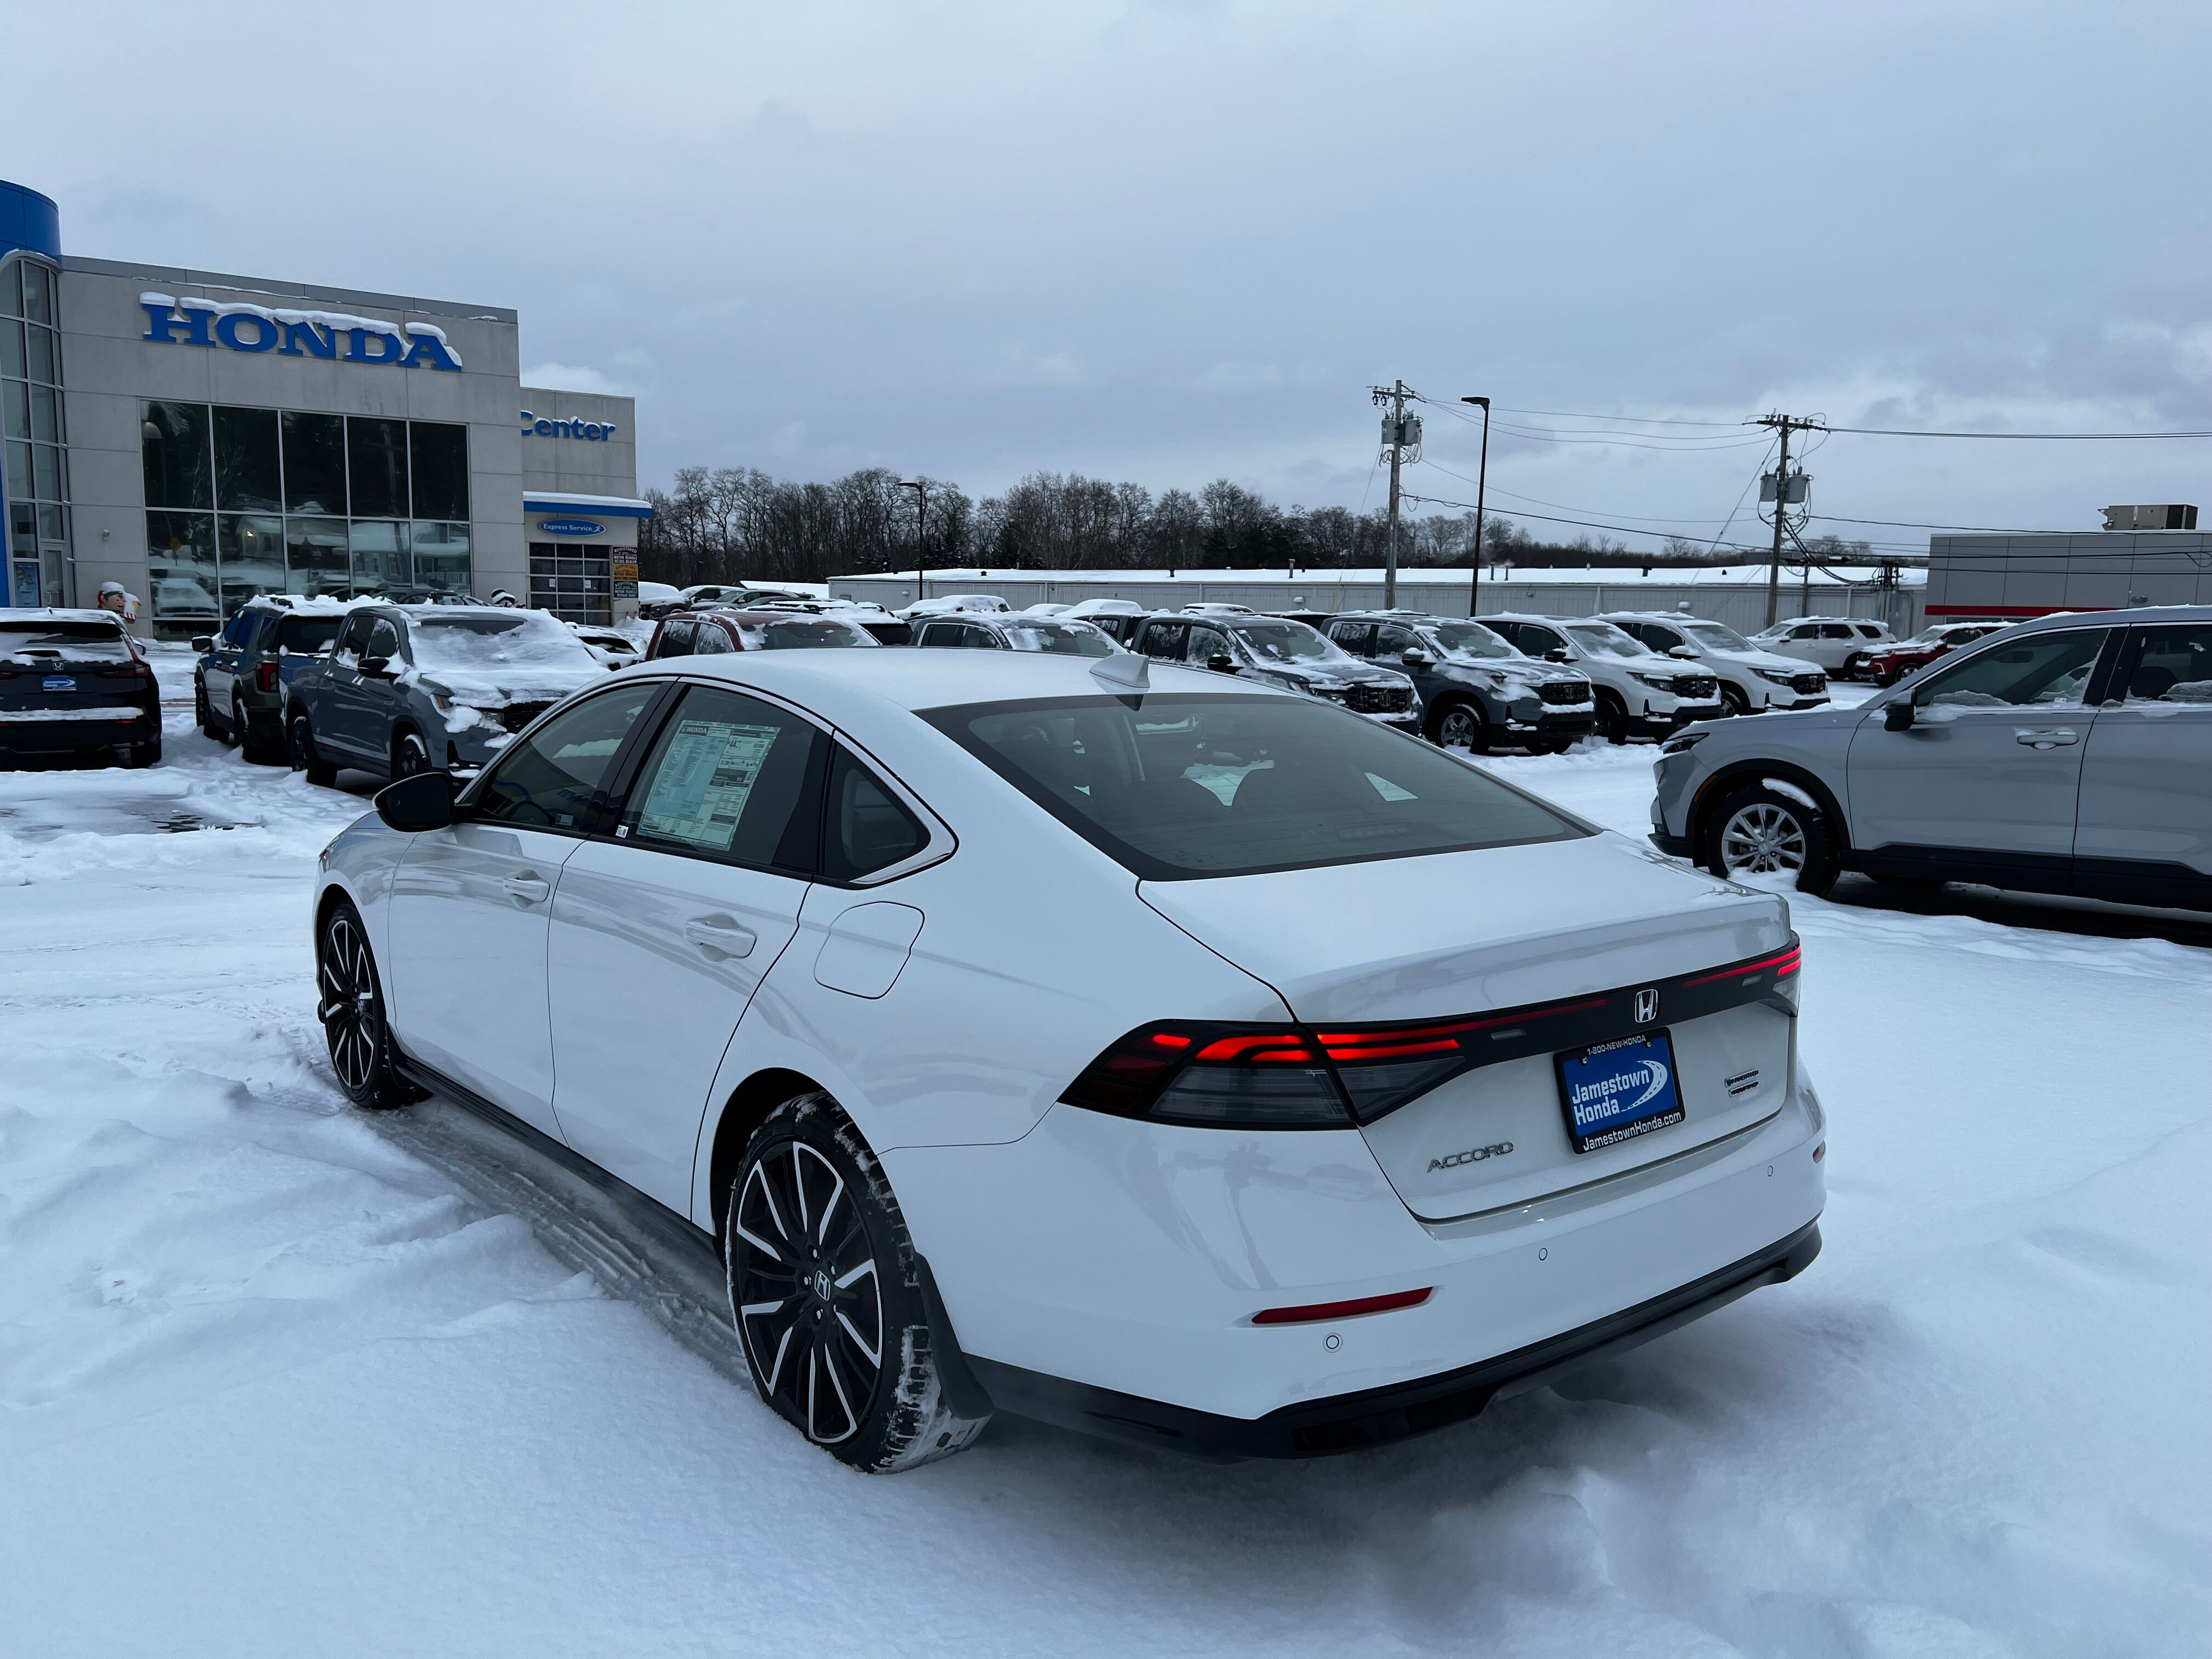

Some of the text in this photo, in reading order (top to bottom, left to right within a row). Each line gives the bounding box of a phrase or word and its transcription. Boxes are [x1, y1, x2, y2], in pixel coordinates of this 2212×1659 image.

[139, 302, 462, 372] HONDA
[1587, 1034, 1646, 1056] 1-800-NEW-HONDA
[1572, 1069, 1650, 1104] Jamestown
[1573, 1096, 1621, 1126] Honda
[1583, 1111, 1682, 1152] JamestownHonda.com
[1427, 1141, 1514, 1173] ACCORD
